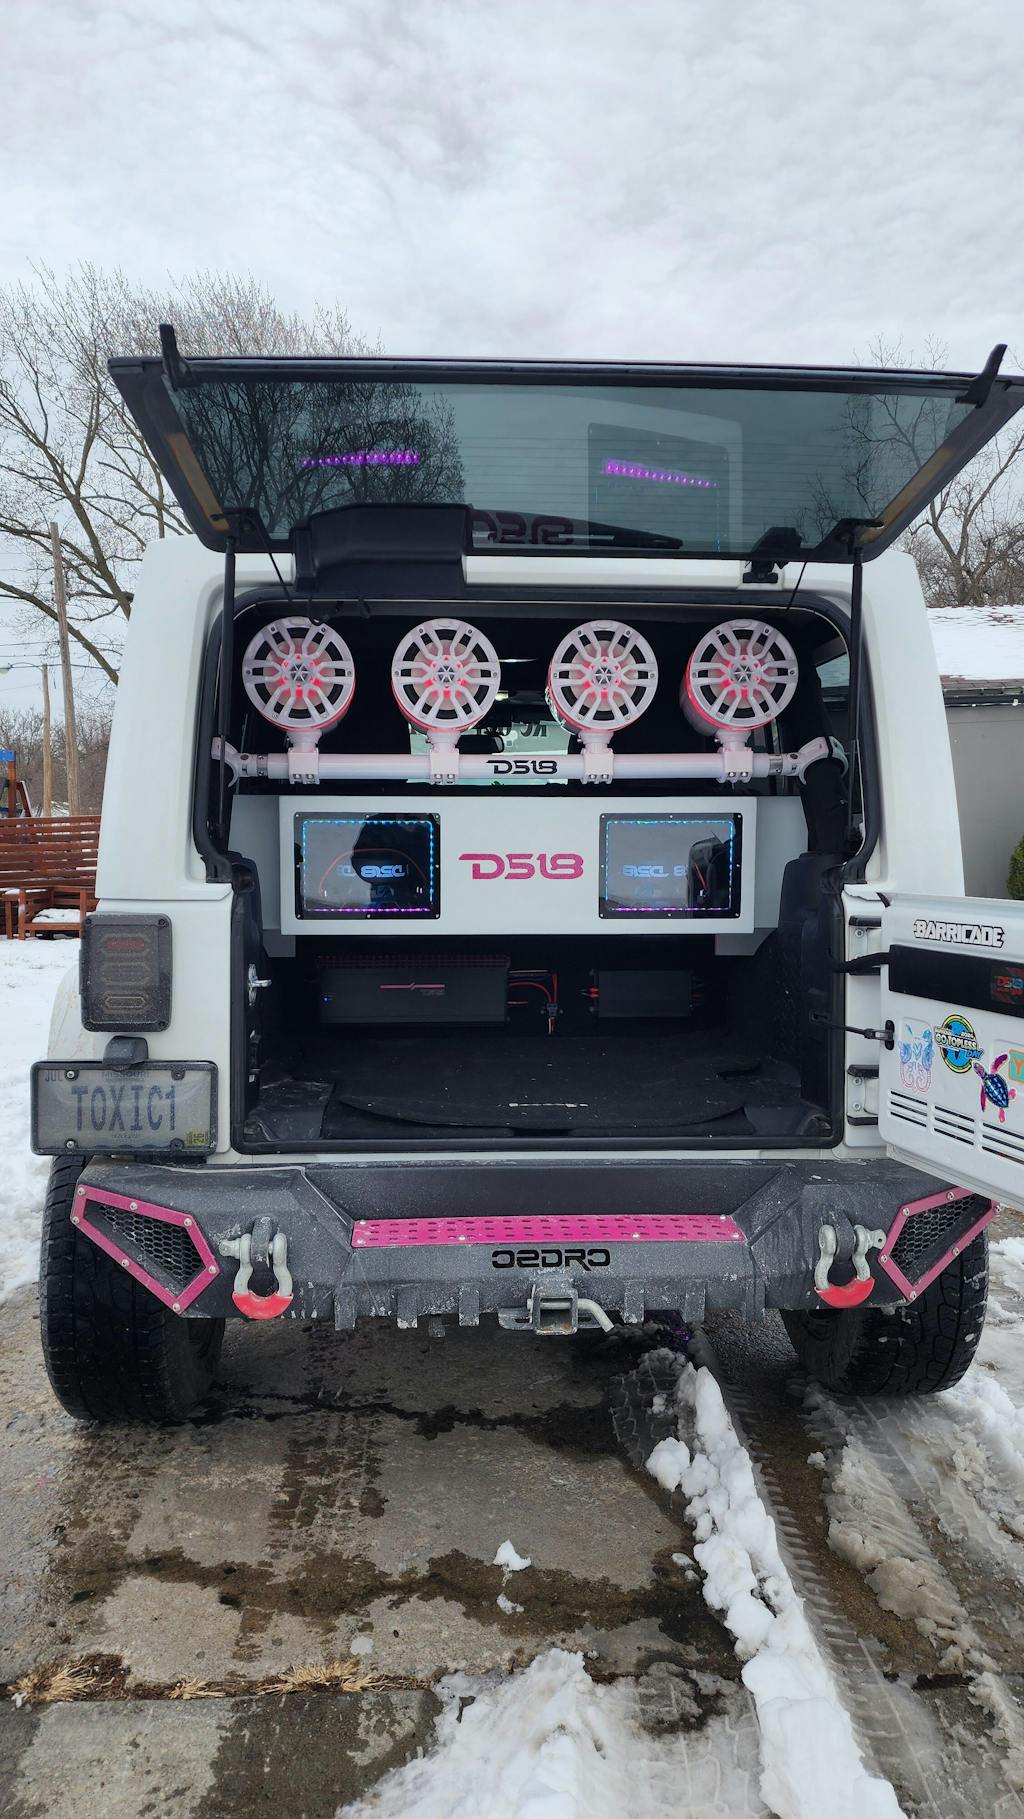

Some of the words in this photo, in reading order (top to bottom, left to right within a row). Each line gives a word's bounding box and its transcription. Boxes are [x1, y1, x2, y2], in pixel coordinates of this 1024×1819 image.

[913, 919, 1005, 948] BARRICADE
[935, 1033, 947, 1044] GO
[947, 1036, 977, 1050] TOPLESS
[966, 1049, 984, 1059] DAY
[45, 1070, 63, 1082] JUL
[71, 1085, 176, 1131] TOXIC1
[491, 1248, 611, 1271] OEDRO
